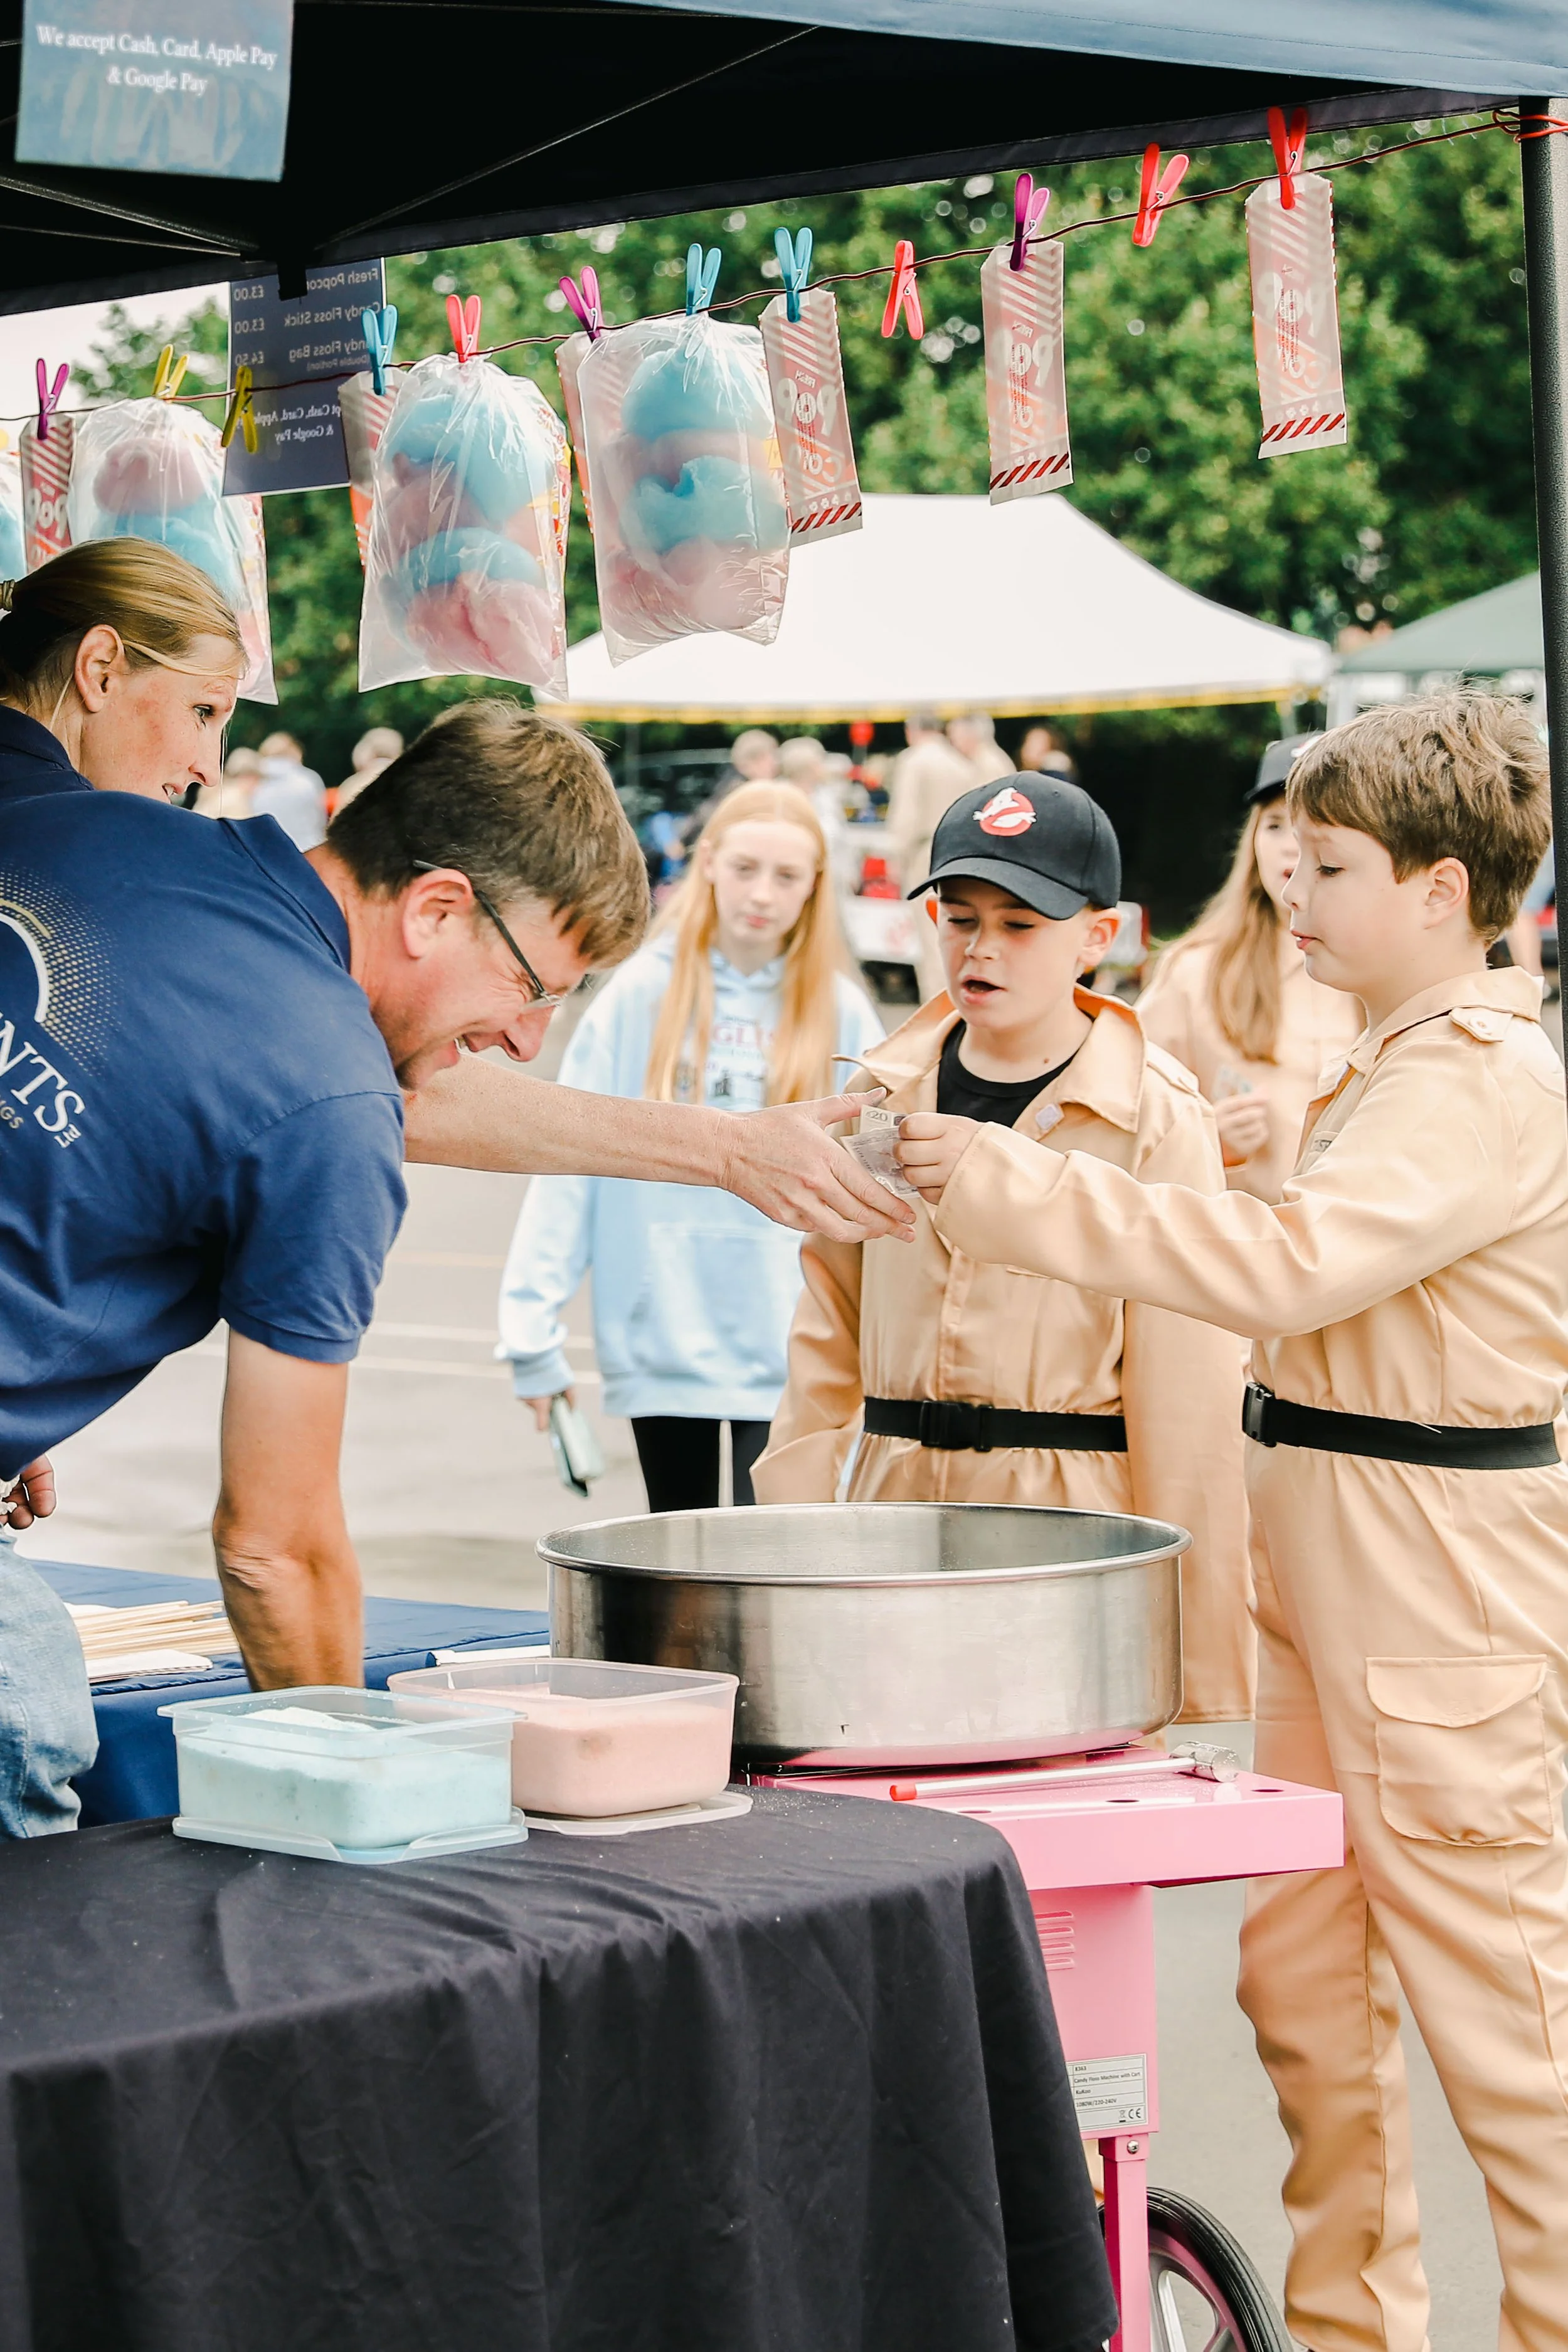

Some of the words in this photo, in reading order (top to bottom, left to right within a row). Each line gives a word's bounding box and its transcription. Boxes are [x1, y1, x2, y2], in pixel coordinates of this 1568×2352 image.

[36, 24, 63, 46] We
[66, 33, 115, 55] accept
[119, 34, 158, 56] Cash,
[163, 38, 202, 60] Card,
[206, 43, 247, 67] Apple
[250, 47, 278, 71] Pay
[107, 66, 121, 85] &
[125, 67, 177, 93] Google
[179, 73, 208, 97] Pay
[0, 1012, 86, 1133] NTS
[54, 1123, 82, 1149] Ltd
